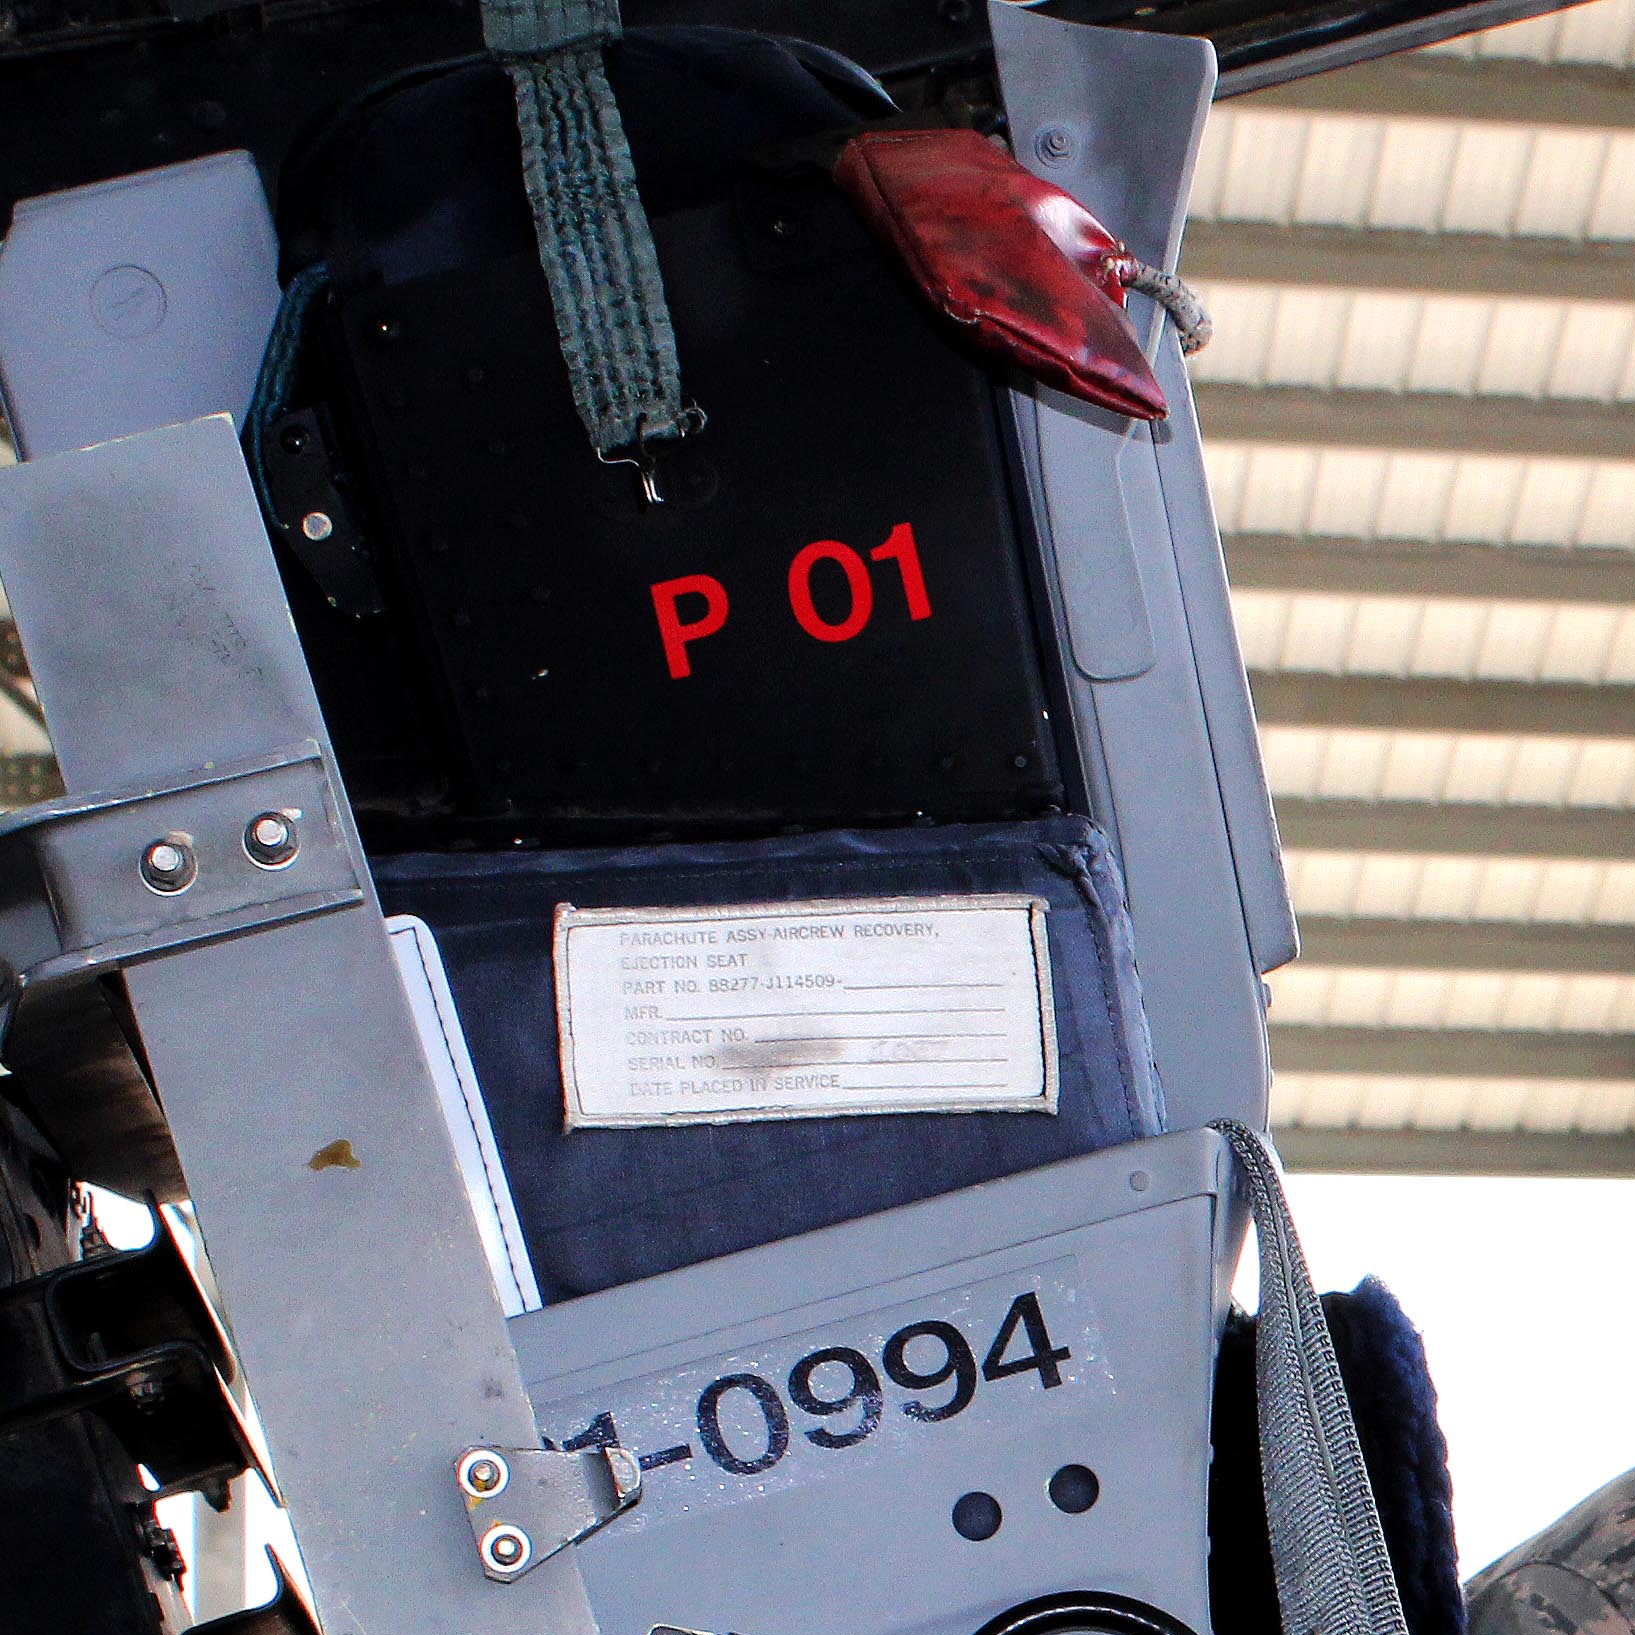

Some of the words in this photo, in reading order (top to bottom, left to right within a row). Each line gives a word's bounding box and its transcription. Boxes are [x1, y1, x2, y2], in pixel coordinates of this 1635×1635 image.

[650, 573, 730, 680] P
[787, 521, 933, 643] 01
[619, 930, 718, 946] PARACHUTE
[854, 923, 940, 938] RECOVERY,
[622, 955, 698, 970] EJECTION
[706, 953, 749, 969] SEAT
[623, 980, 666, 995] PART
[627, 1029, 713, 1045] CONTRACT
[628, 1055, 686, 1071] SERIAL
[630, 1082, 674, 1097] DATE
[681, 1078, 743, 1095] PLACED
[750, 1077, 768, 1092] IN
[774, 1073, 841, 1090] SERVICE
